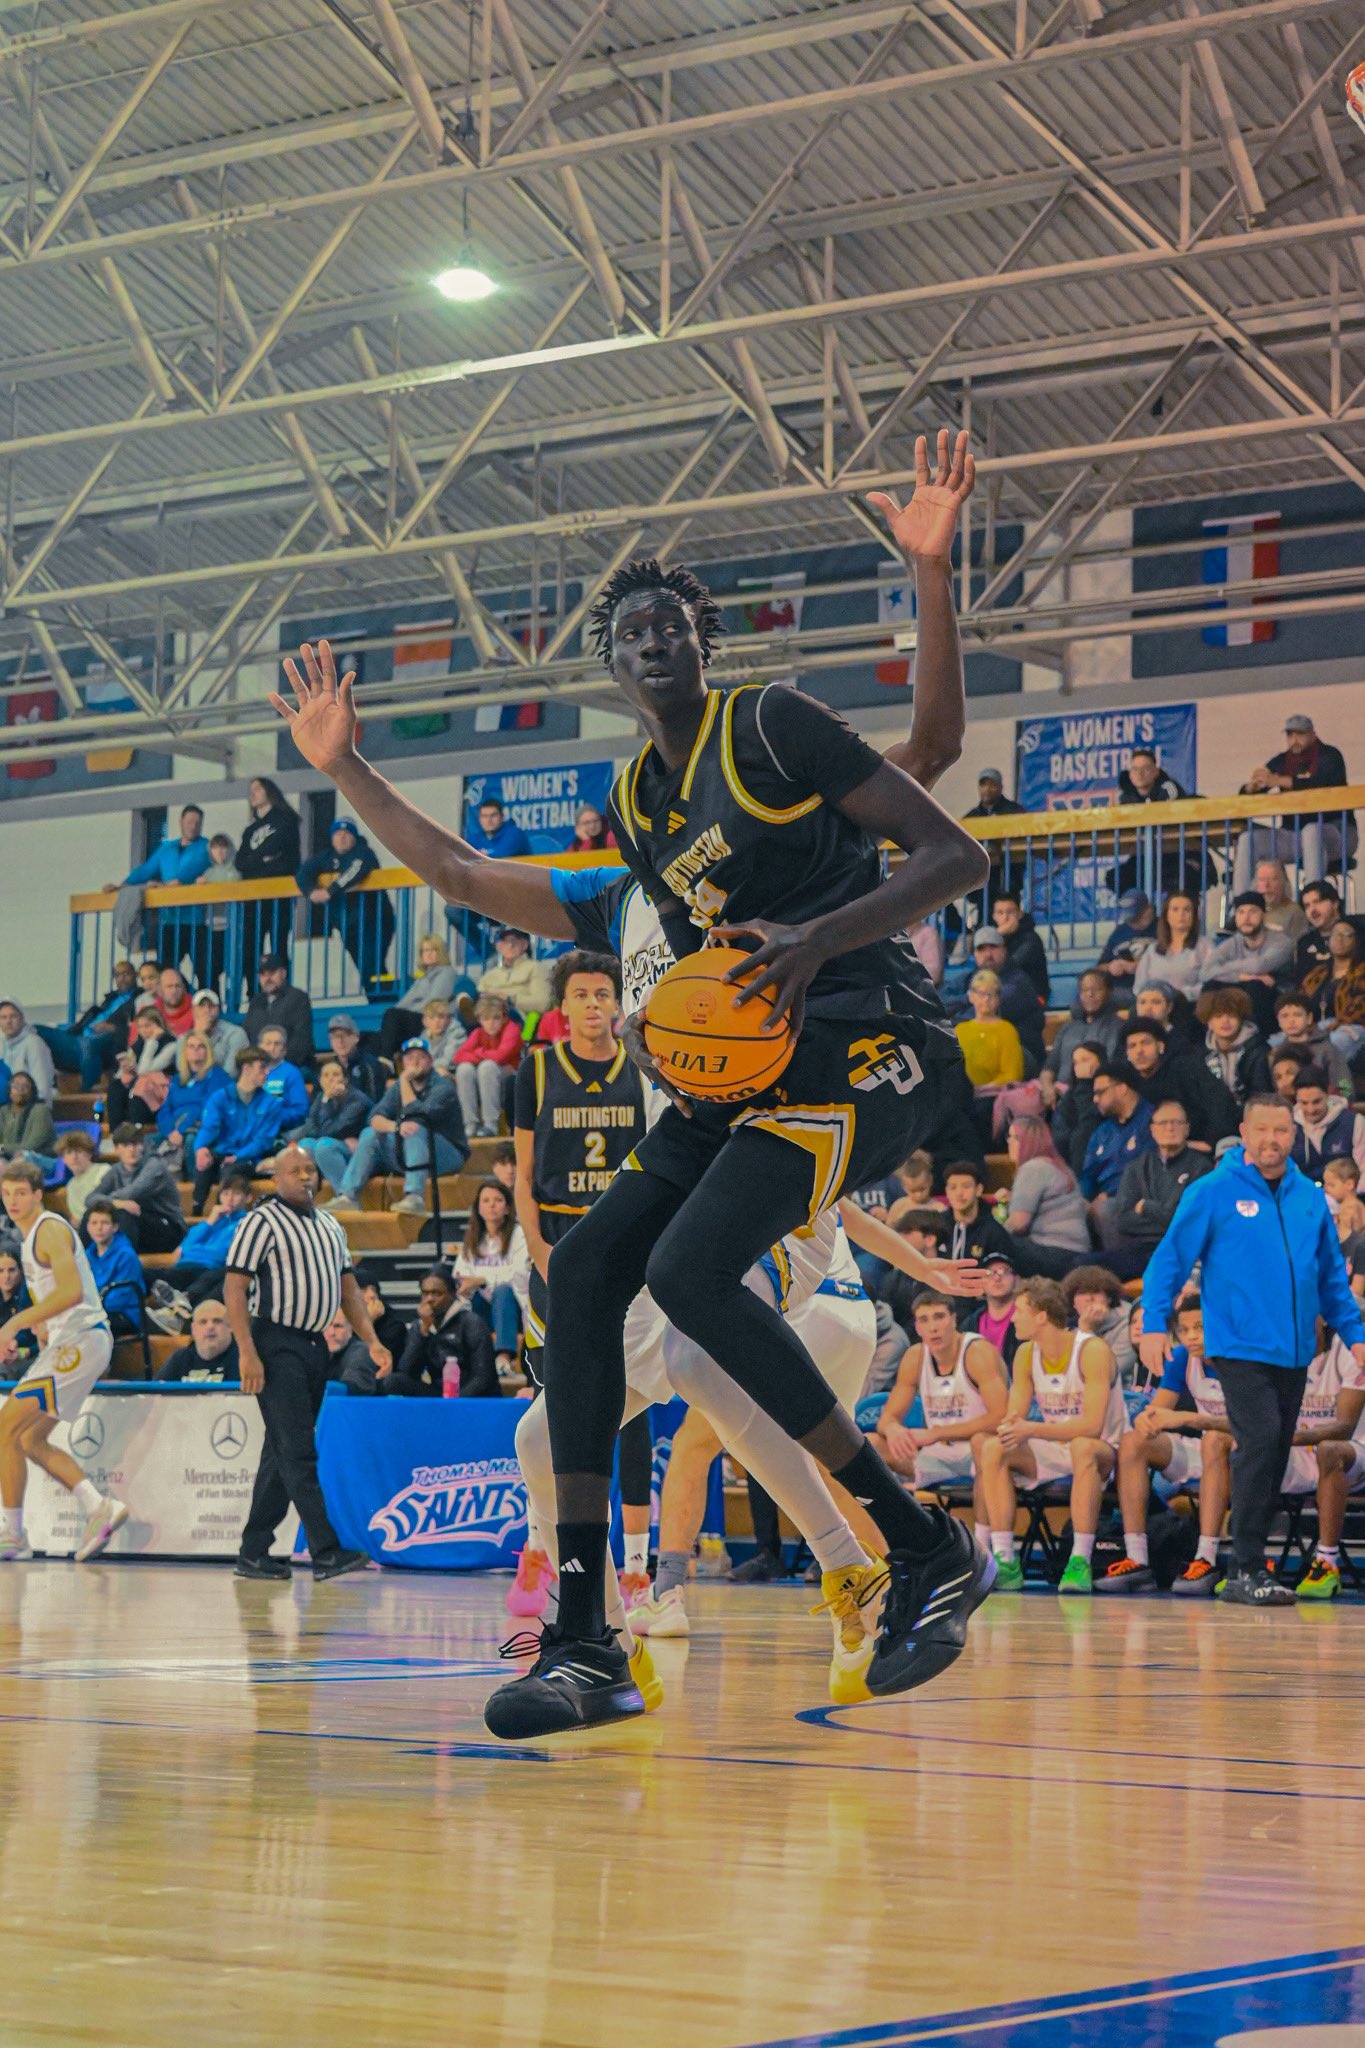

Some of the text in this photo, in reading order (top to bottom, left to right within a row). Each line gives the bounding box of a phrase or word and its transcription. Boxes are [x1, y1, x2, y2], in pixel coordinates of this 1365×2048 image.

[1062, 713, 1154, 749] WOMEN'S
[501, 769, 579, 803] WOMEN'S
[670, 1050, 728, 1073] EVO
[553, 1106, 635, 1128] HUNTINGTON
[584, 1131, 606, 1168] 2
[413, 1461, 487, 1485] THOMAS
[374, 1480, 529, 1546] SAINTS
